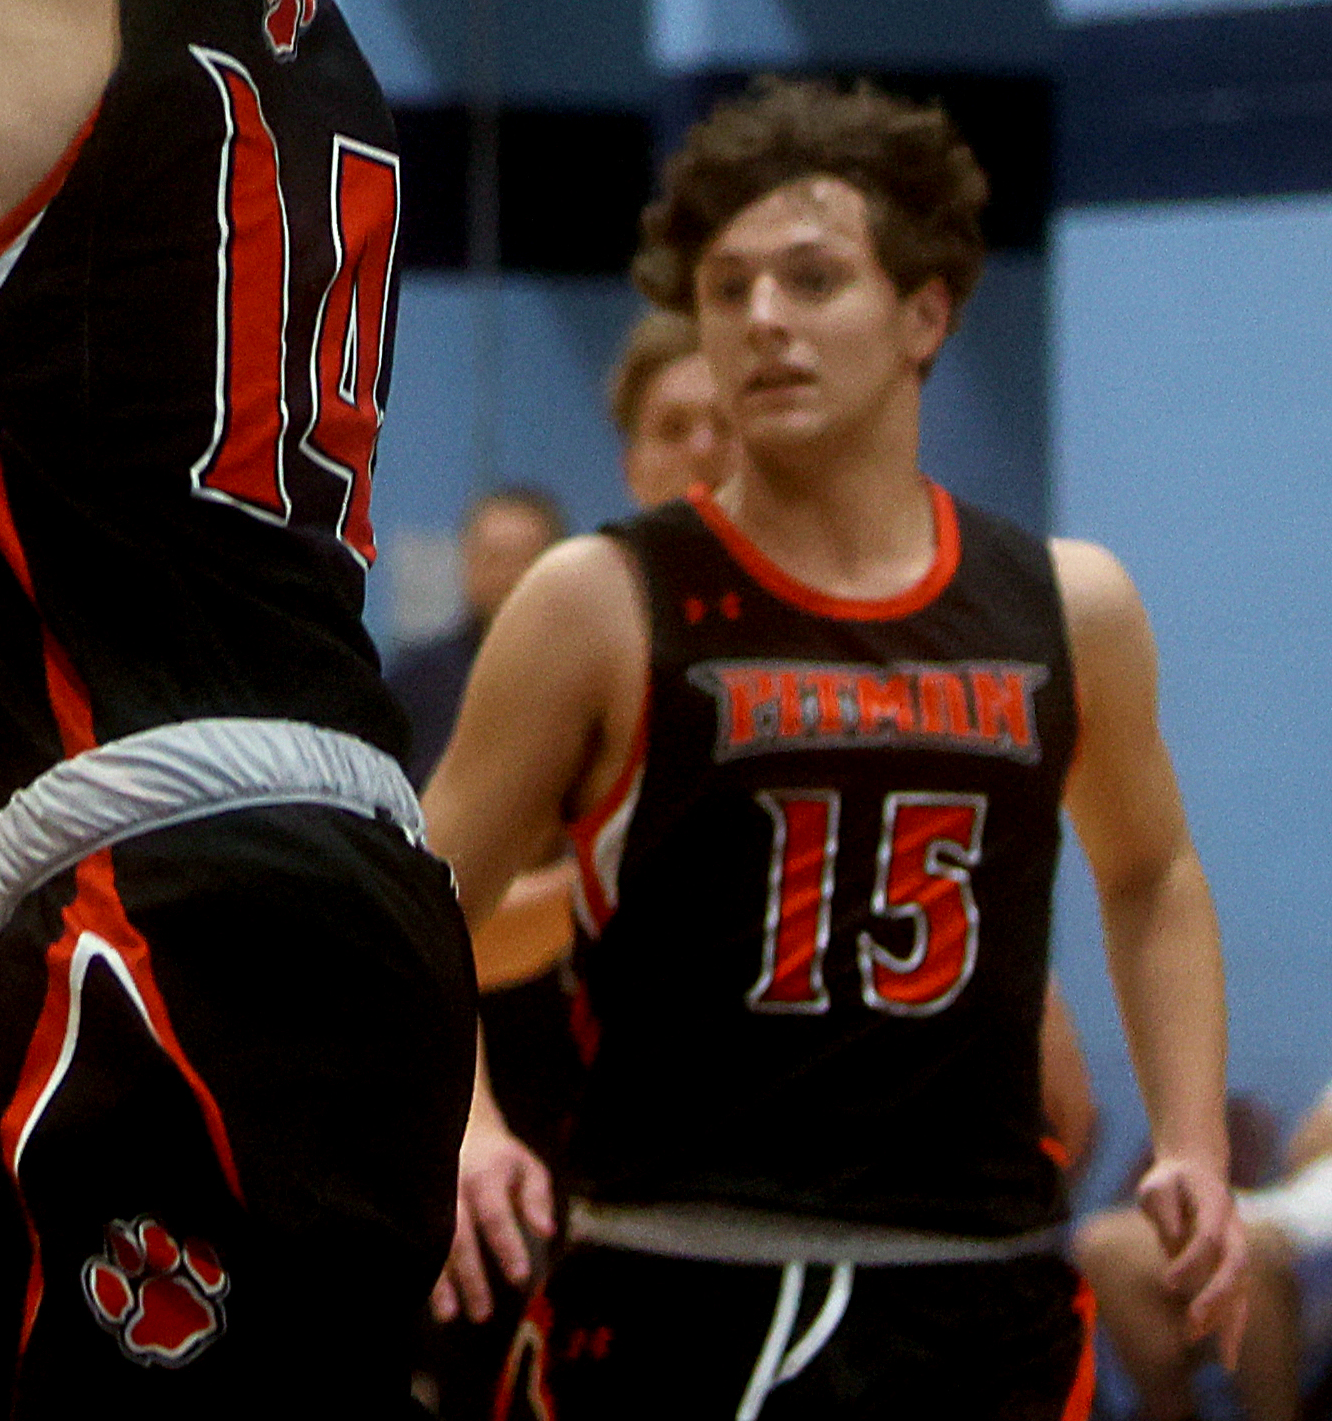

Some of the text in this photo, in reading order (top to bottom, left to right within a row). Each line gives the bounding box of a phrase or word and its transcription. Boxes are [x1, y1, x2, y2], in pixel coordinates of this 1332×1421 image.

[189, 43, 399, 569] 14
[702, 662, 1043, 760] PITMAN
[745, 788, 987, 1016] 15
